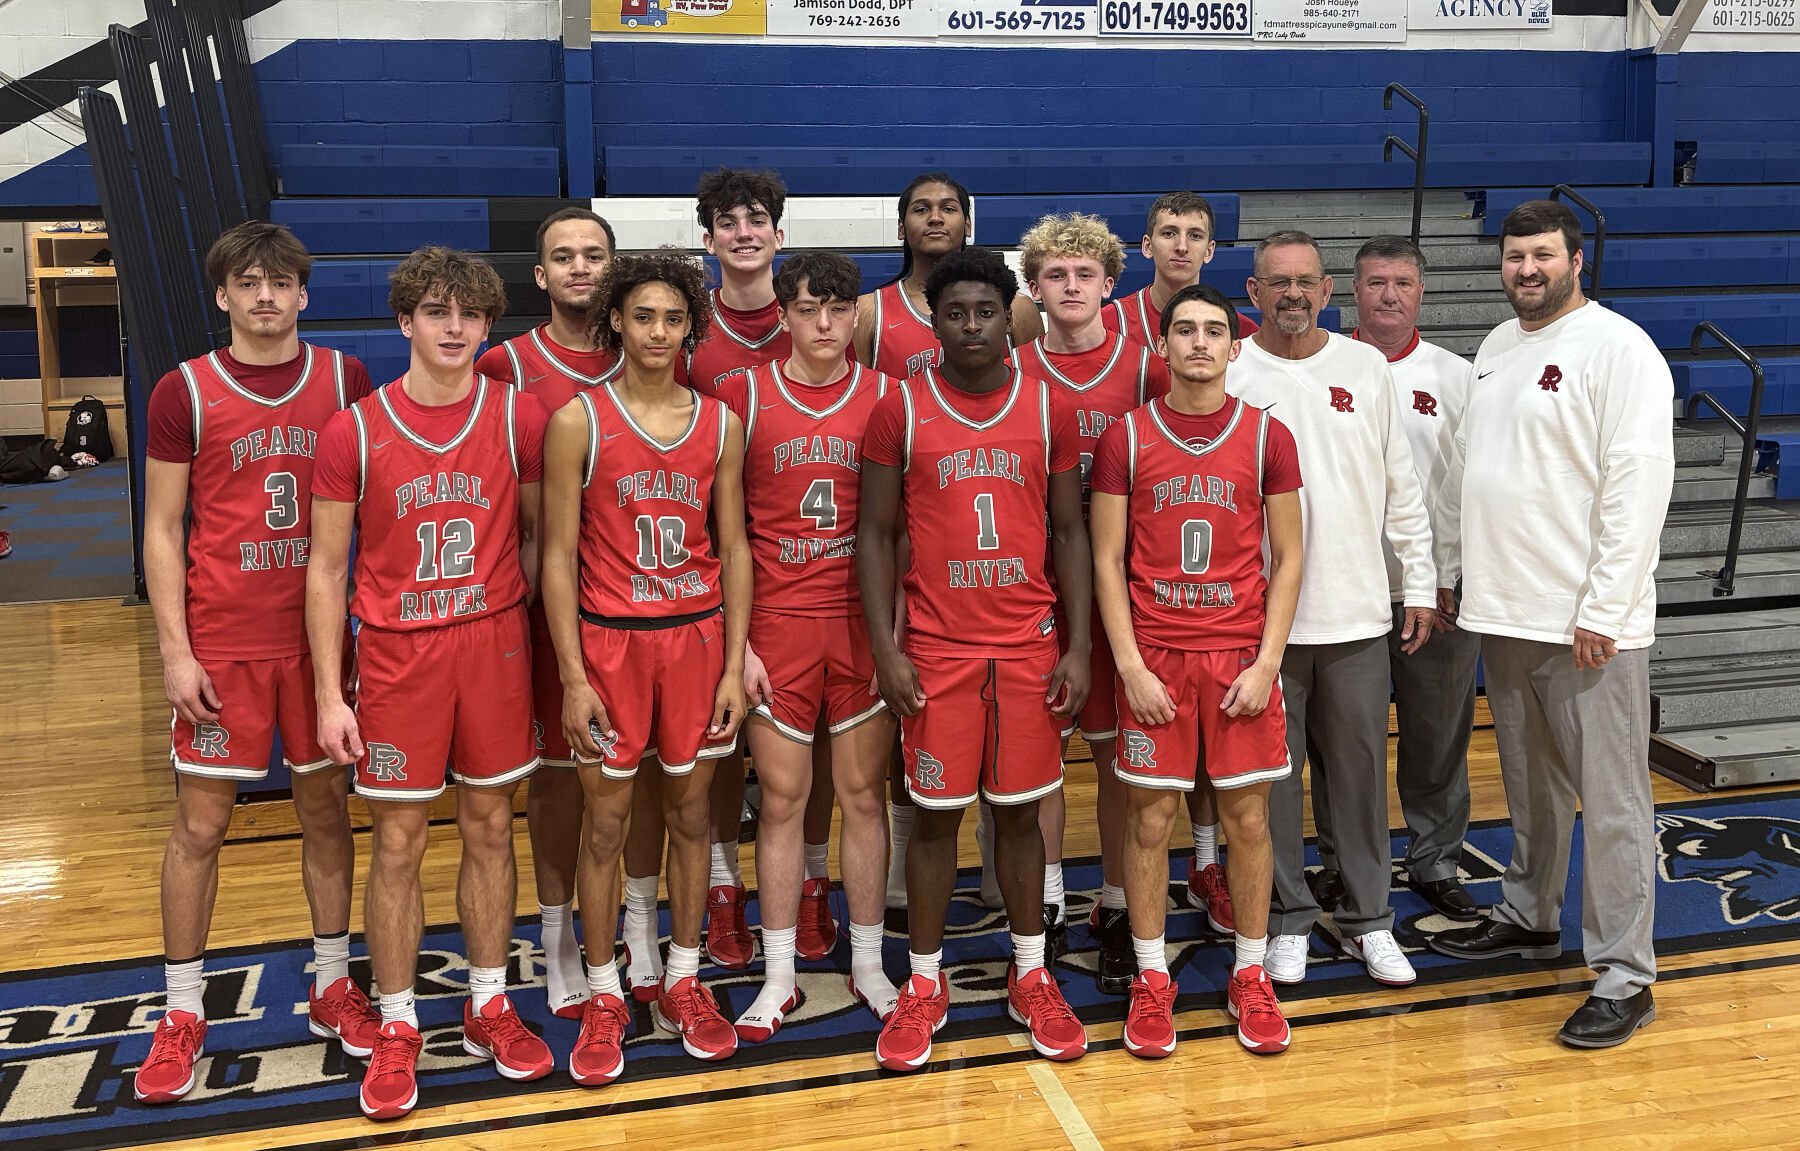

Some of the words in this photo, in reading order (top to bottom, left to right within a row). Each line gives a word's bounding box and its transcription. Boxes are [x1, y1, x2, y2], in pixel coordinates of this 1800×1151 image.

[794, 0, 845, 8] Jamison
[849, 0, 886, 11] Dodd,
[890, 0, 913, 10] DPT
[808, 15, 900, 27] 769-242-2636
[948, 10, 1086, 30] 601-569-7125
[1105, 1, 1248, 30] 601-749-9563
[1303, 9, 1360, 17] 985-640-2171
[1436, 0, 1526, 17] AGENCY
[1712, 10, 1795, 27] 601-215-0625
[1263, 20, 1397, 30] fdmattresspicayune@gmail.com
[1329, 386, 1354, 413] PR
[1412, 390, 1437, 416] PR
[774, 435, 860, 473] PEARL
[937, 448, 1025, 489] PEARL
[264, 471, 299, 530] 3
[395, 472, 490, 519] PEARL
[617, 470, 702, 511] PEARL
[800, 479, 838, 530] 4
[1153, 475, 1238, 514] PEARL
[973, 493, 999, 550] 1
[239, 537, 312, 571] RIVE
[416, 518, 476, 582] 12
[635, 515, 691, 569] 10
[778, 534, 856, 564] RIVER
[1180, 519, 1213, 574] 0
[630, 570, 709, 602] RIVER
[948, 557, 1029, 588] RIVER
[400, 584, 487, 621] RIVER
[1154, 580, 1236, 609] RIVER
[366, 742, 407, 781] PR
[1123, 729, 1156, 768] PR
[914, 749, 945, 790] PR
